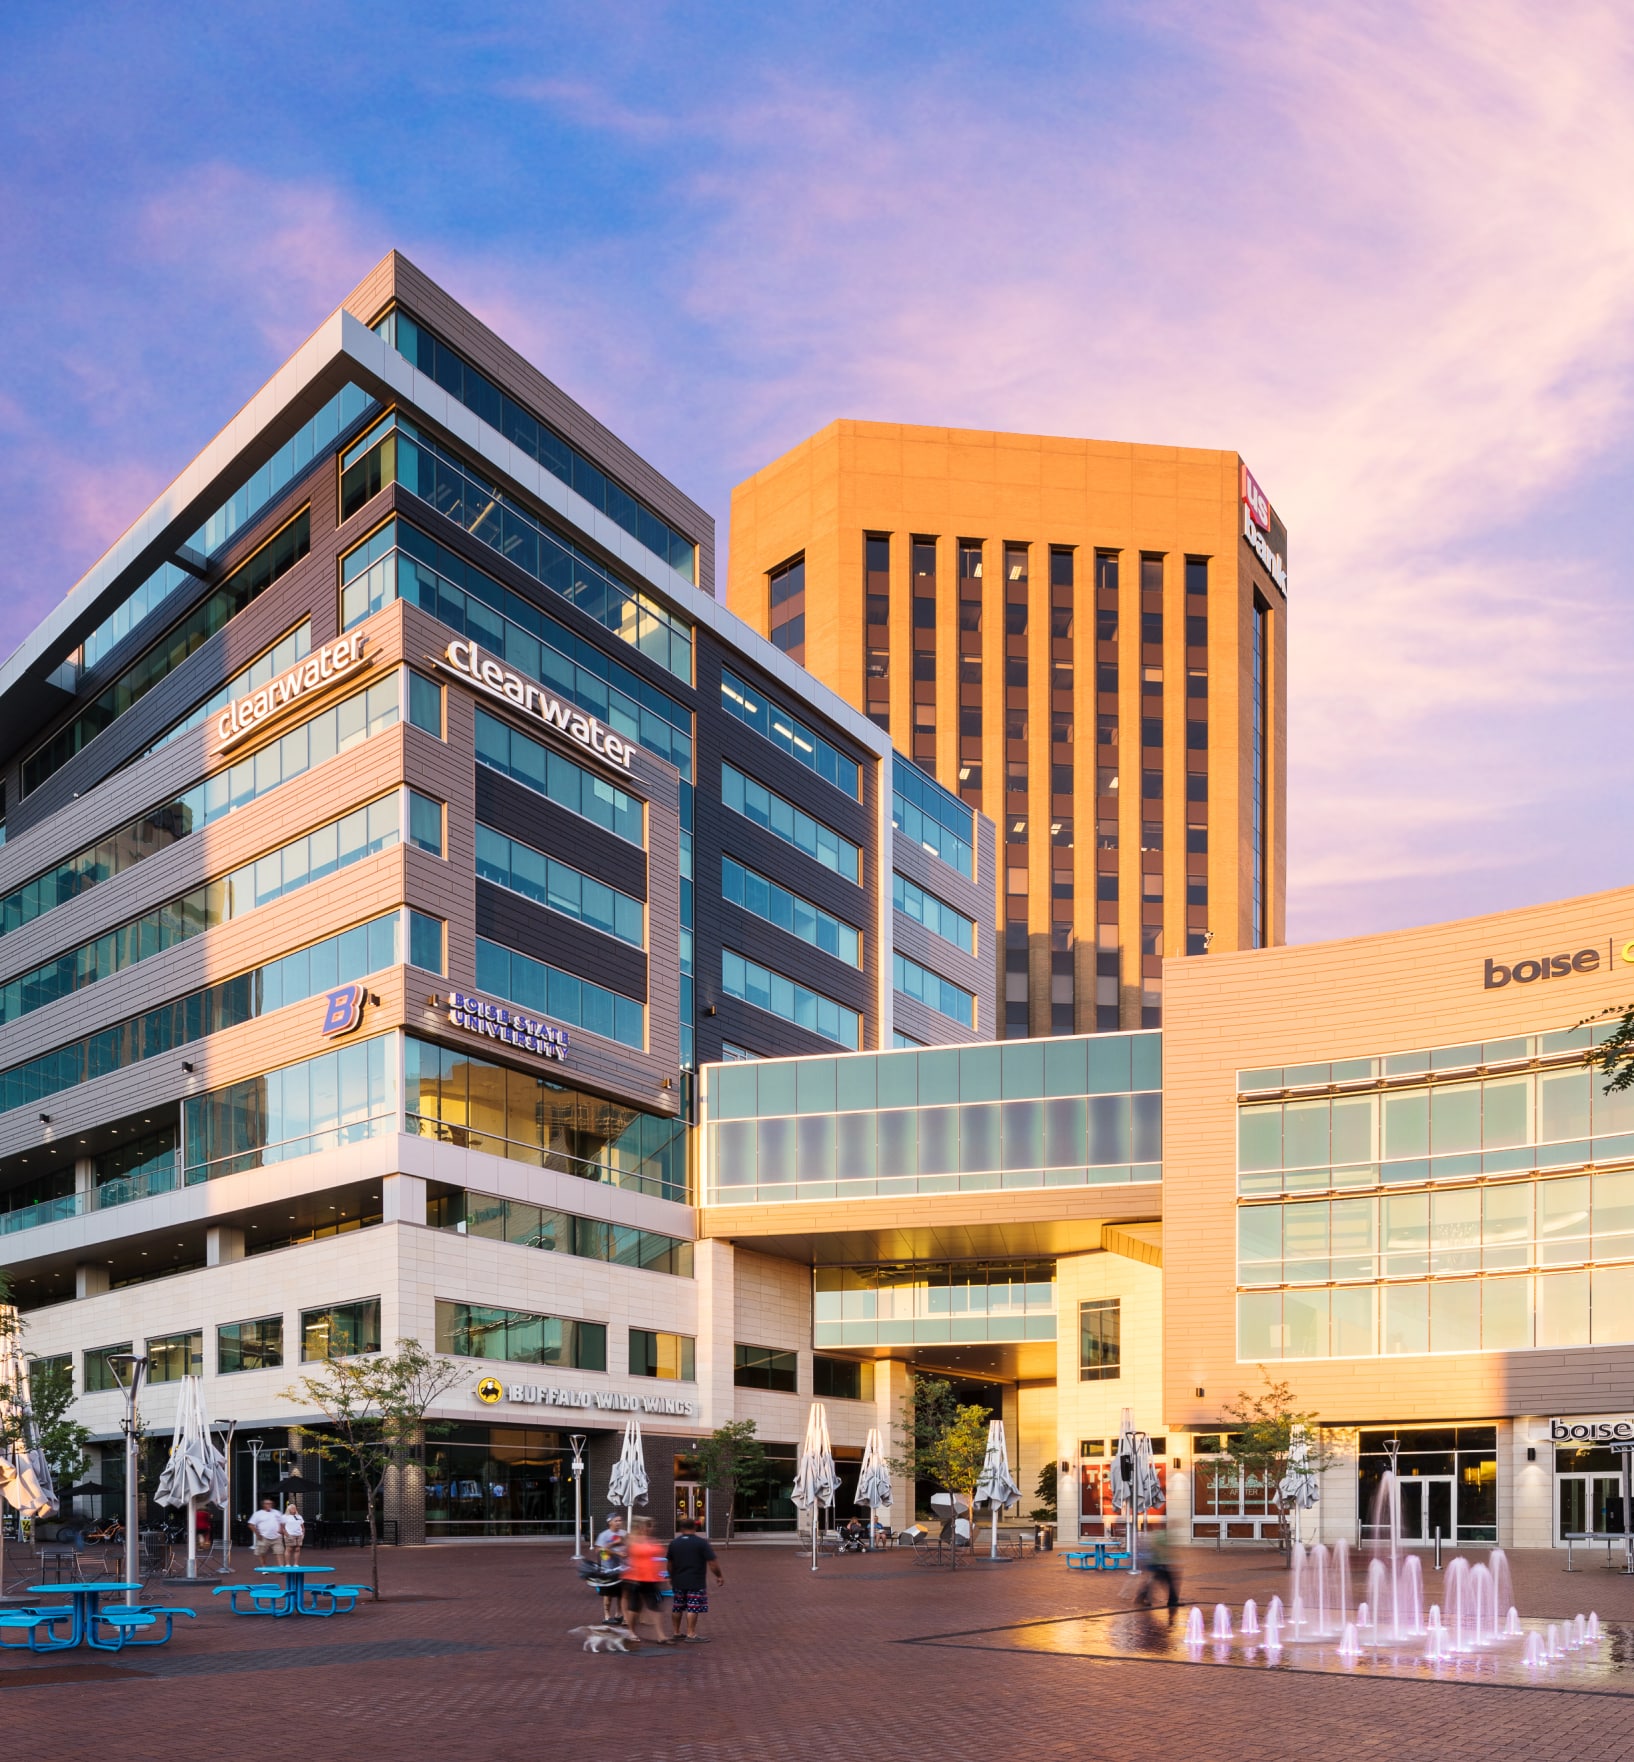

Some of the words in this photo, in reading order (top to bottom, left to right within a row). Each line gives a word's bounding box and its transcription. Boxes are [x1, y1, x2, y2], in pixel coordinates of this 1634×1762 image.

[1244, 503, 1288, 597] bank
[218, 630, 366, 740] clearwater
[445, 640, 636, 769] clearwater
[1484, 949, 1600, 989] boise
[321, 984, 364, 1039] B
[448, 1009, 569, 1061] UNIVERSITY
[449, 992, 511, 1026] BOISE
[513, 1015, 570, 1047] STATE
[508, 1384, 591, 1408] BUFFALO
[595, 1392, 639, 1411] WILD
[644, 1396, 693, 1416] WINGS
[1550, 1418, 1633, 1440] boise
